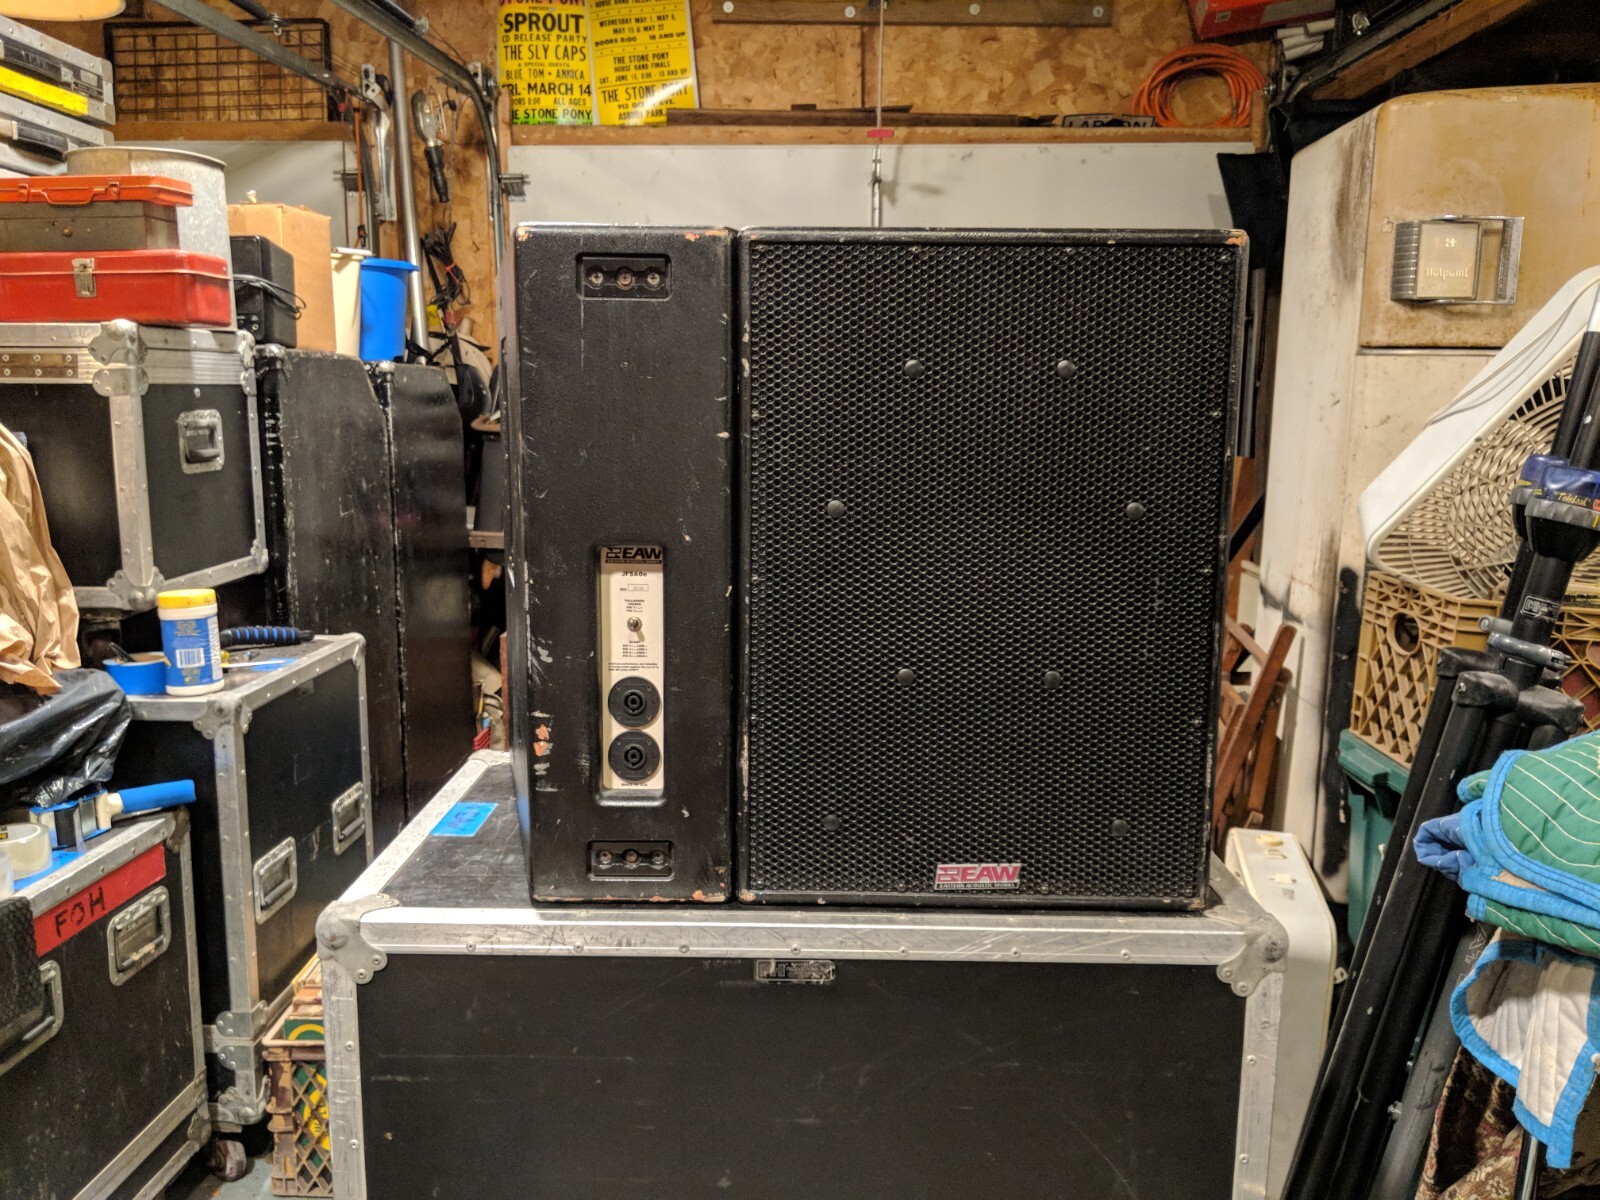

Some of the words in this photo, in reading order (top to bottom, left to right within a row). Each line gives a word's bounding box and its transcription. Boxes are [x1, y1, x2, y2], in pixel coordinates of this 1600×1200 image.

[503, 12, 584, 33] SPROUT
[502, 34, 510, 43] CD
[514, 33, 552, 42] RELEASE
[556, 34, 588, 43] PARTY
[503, 44, 523, 62] THE
[527, 44, 549, 60] SLY
[555, 45, 586, 61] CAPS
[613, 56, 626, 65] THE
[628, 54, 649, 63] STONE
[652, 52, 669, 61] PONY
[505, 68, 522, 80] BLUE
[528, 69, 545, 79] TOM
[527, 82, 574, 96] MARCH
[579, 84, 592, 96] 14
[554, 97, 565, 105] ALL
[568, 98, 586, 106] AGES
[601, 88, 620, 104] THE
[523, 108, 558, 119] STONE
[562, 109, 592, 120] PONY
[622, 547, 662, 559] EAW
[960, 866, 1020, 882] EAW
[54, 886, 106, 938] FOH
